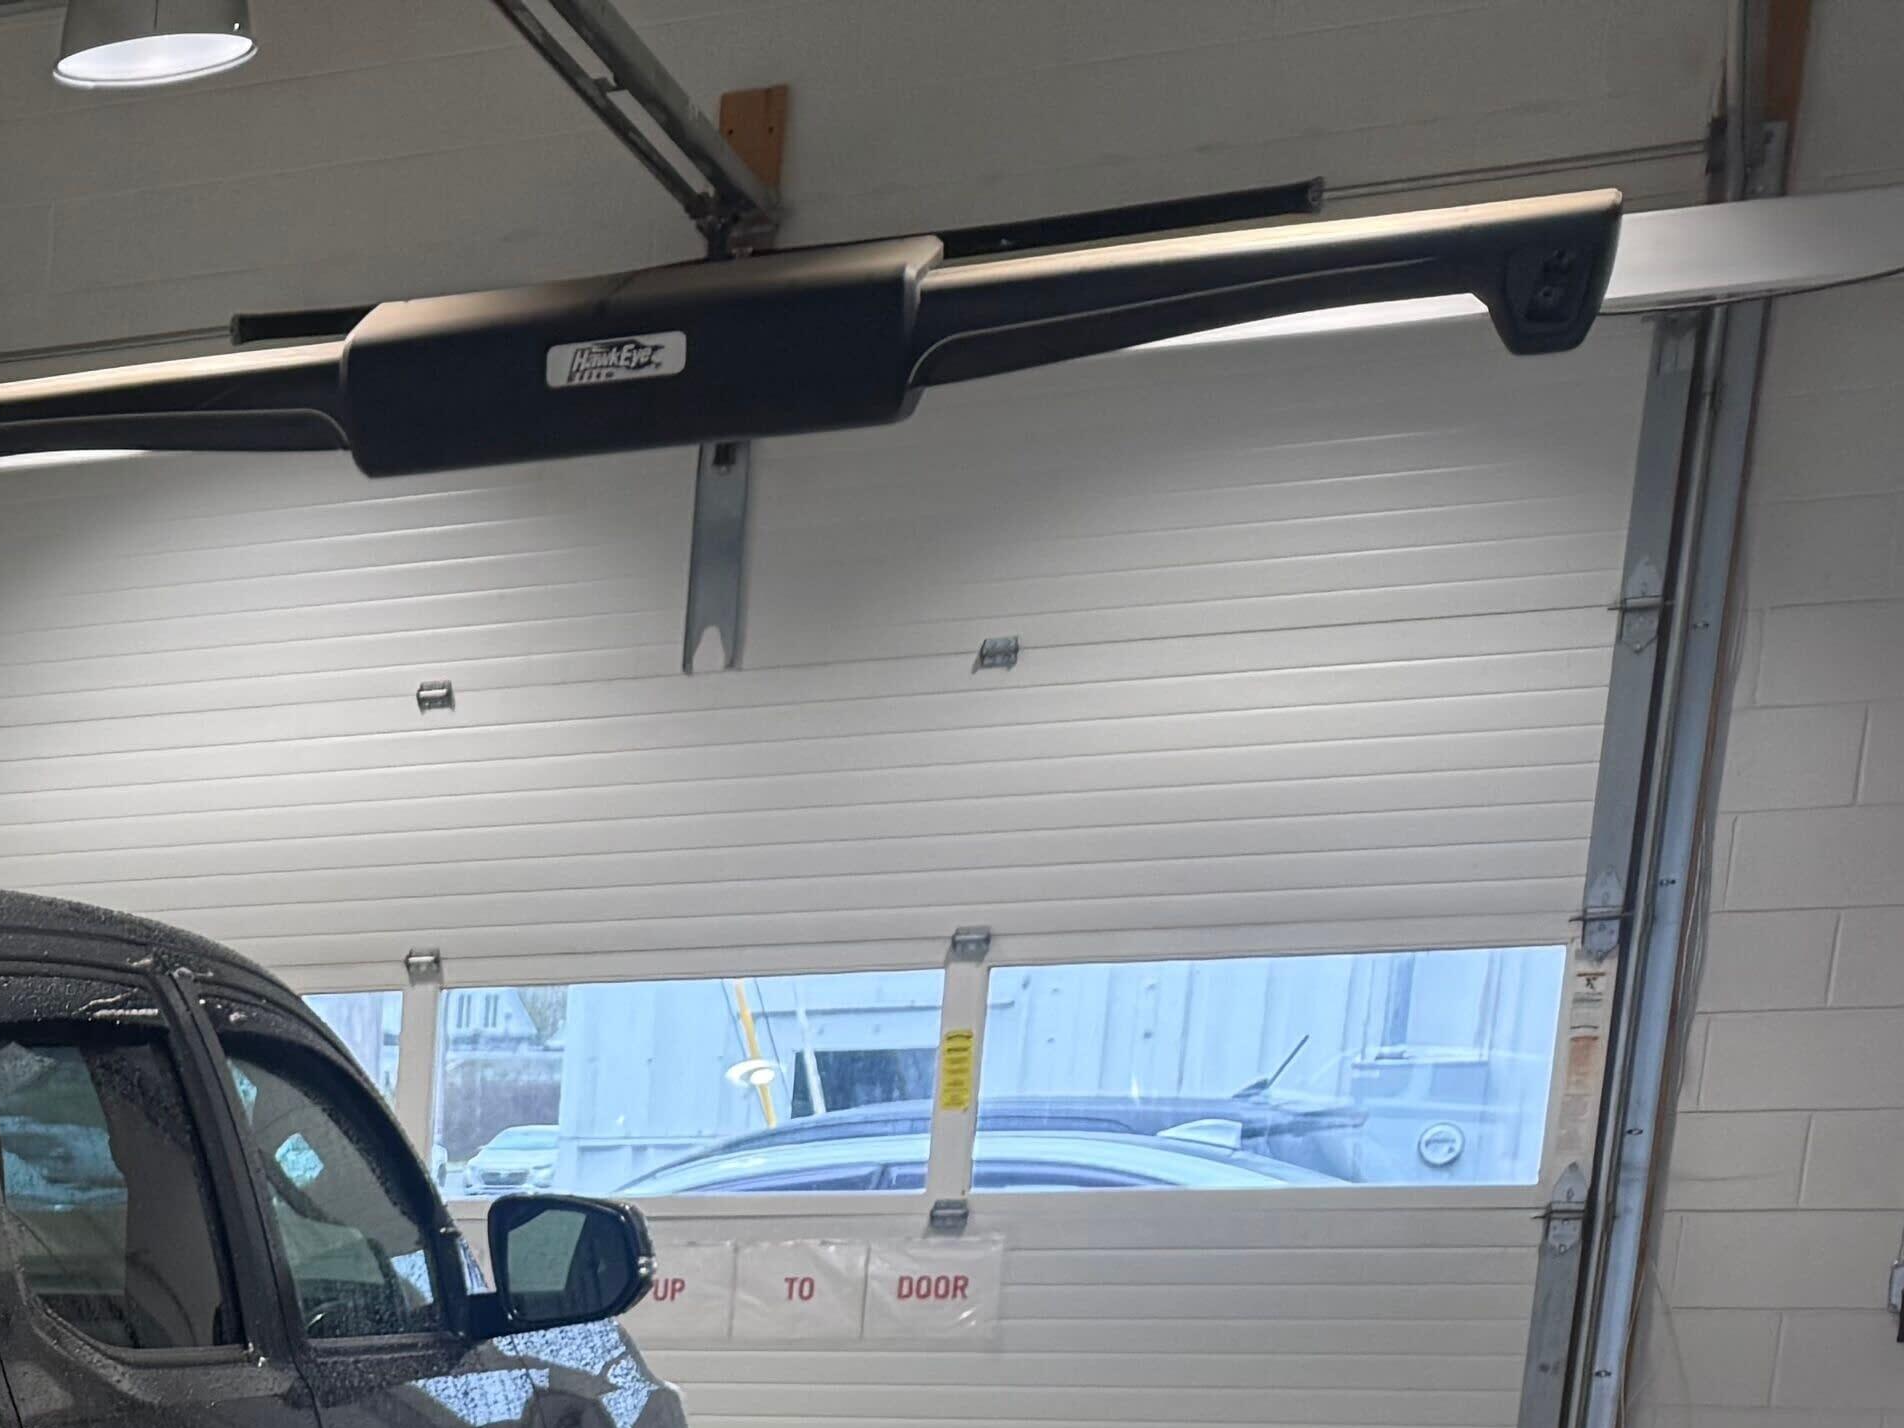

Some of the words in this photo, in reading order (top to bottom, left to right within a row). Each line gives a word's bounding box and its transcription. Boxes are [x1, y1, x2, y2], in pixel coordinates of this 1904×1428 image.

[653, 1277, 686, 1302] UP
[784, 1275, 816, 1301] TO
[896, 1274, 970, 1301] DOOR
